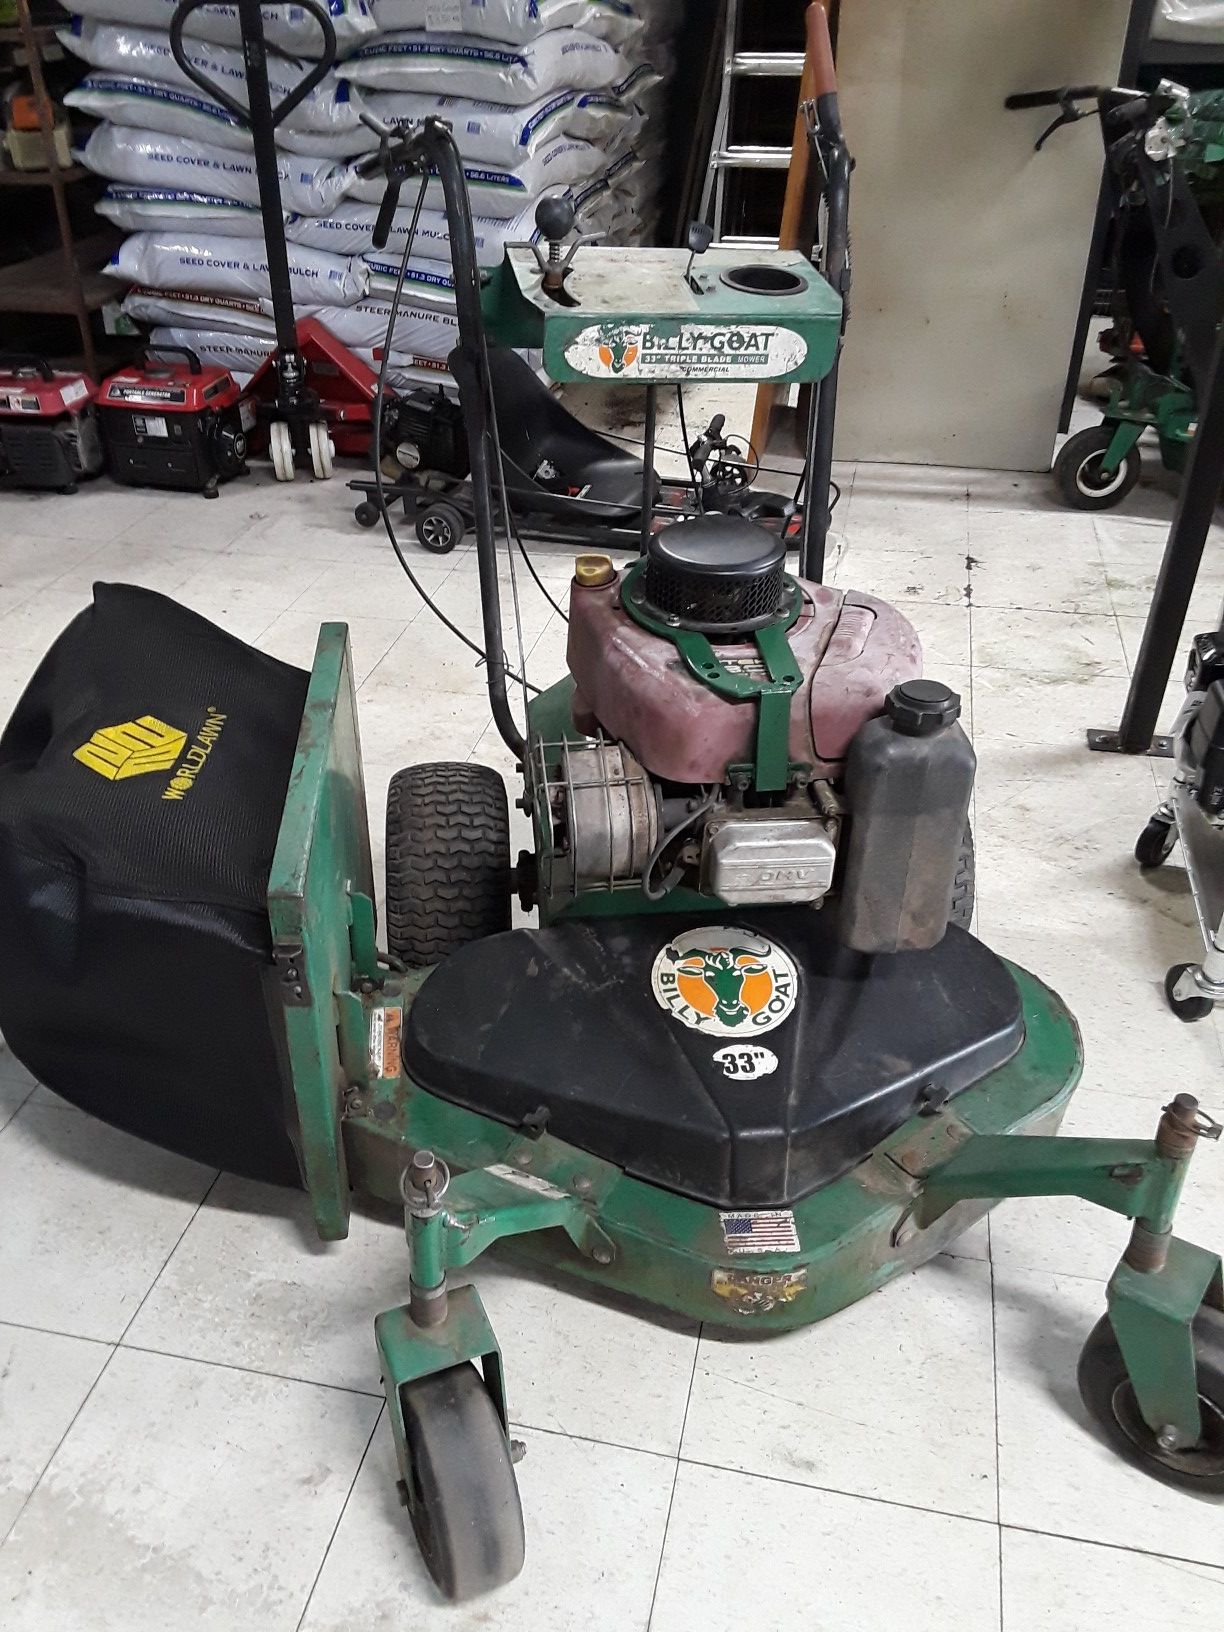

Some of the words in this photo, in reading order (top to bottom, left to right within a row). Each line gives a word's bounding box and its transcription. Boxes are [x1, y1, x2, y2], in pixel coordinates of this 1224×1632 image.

[221, 64, 247, 80] LAW
[147, 152, 174, 164] SEED
[176, 155, 210, 168] COVER
[222, 161, 253, 175] LAWN
[315, 219, 342, 231] SEED
[421, 229, 452, 242] MULC
[178, 256, 204, 267] SEED
[206, 258, 240, 270] COVER
[426, 275, 441, 285] DRY
[200, 296, 215, 304] DRY
[215, 298, 242, 310] QUARTS
[355, 304, 392, 316] STEER
[395, 310, 440, 324] MANURE
[709, 331, 775, 352] GOAT
[664, 355, 698, 364] TRIPLE
[700, 355, 732, 364] BLADE
[737, 355, 766, 364] MOWER
[681, 365, 731, 374] COMMERCIAL
[161, 713, 228, 801] WORLDLAWN
[659, 971, 713, 1026] BILLY
[751, 967, 792, 1027] GOAT
[721, 1051, 766, 1076] 33"
